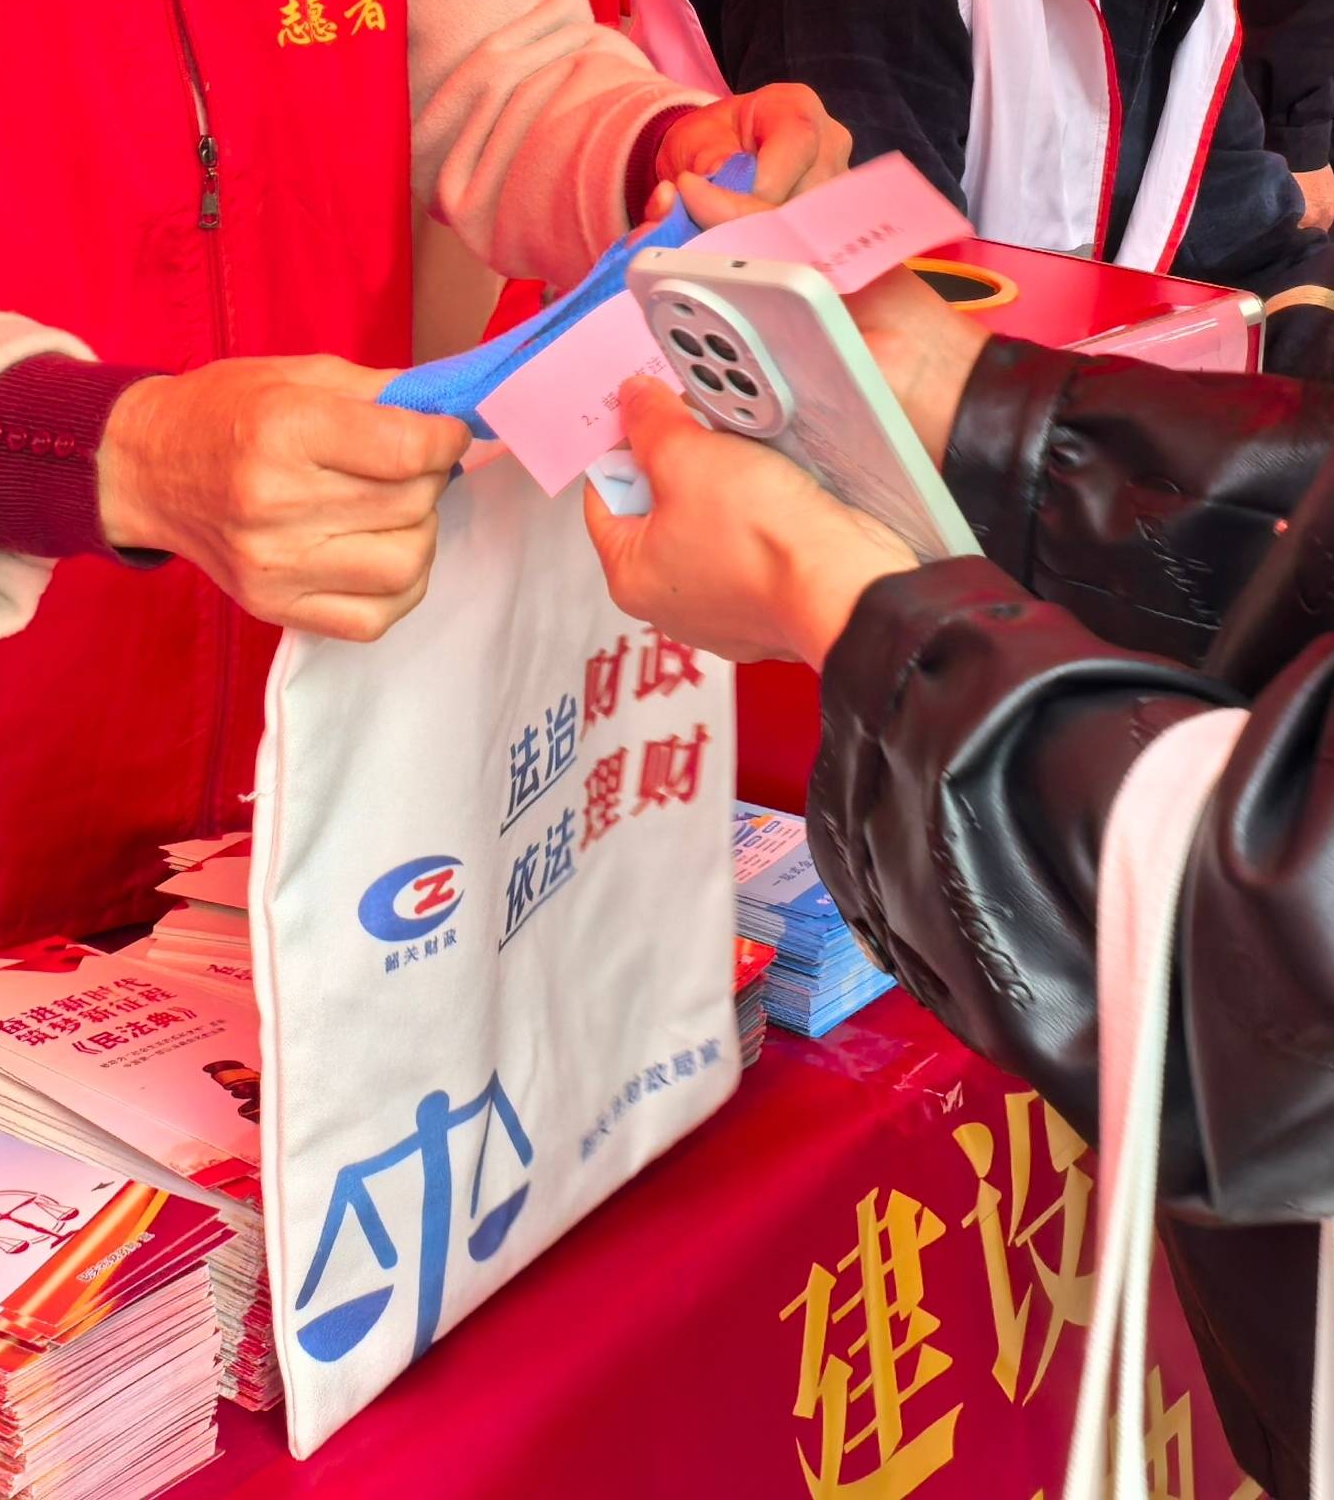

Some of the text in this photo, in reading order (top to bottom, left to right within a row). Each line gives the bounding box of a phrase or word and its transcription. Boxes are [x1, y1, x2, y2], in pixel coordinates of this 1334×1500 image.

[14, 986, 179, 1047] 筑梦新征程
[70, 1005, 198, 1056] 《民法典》
